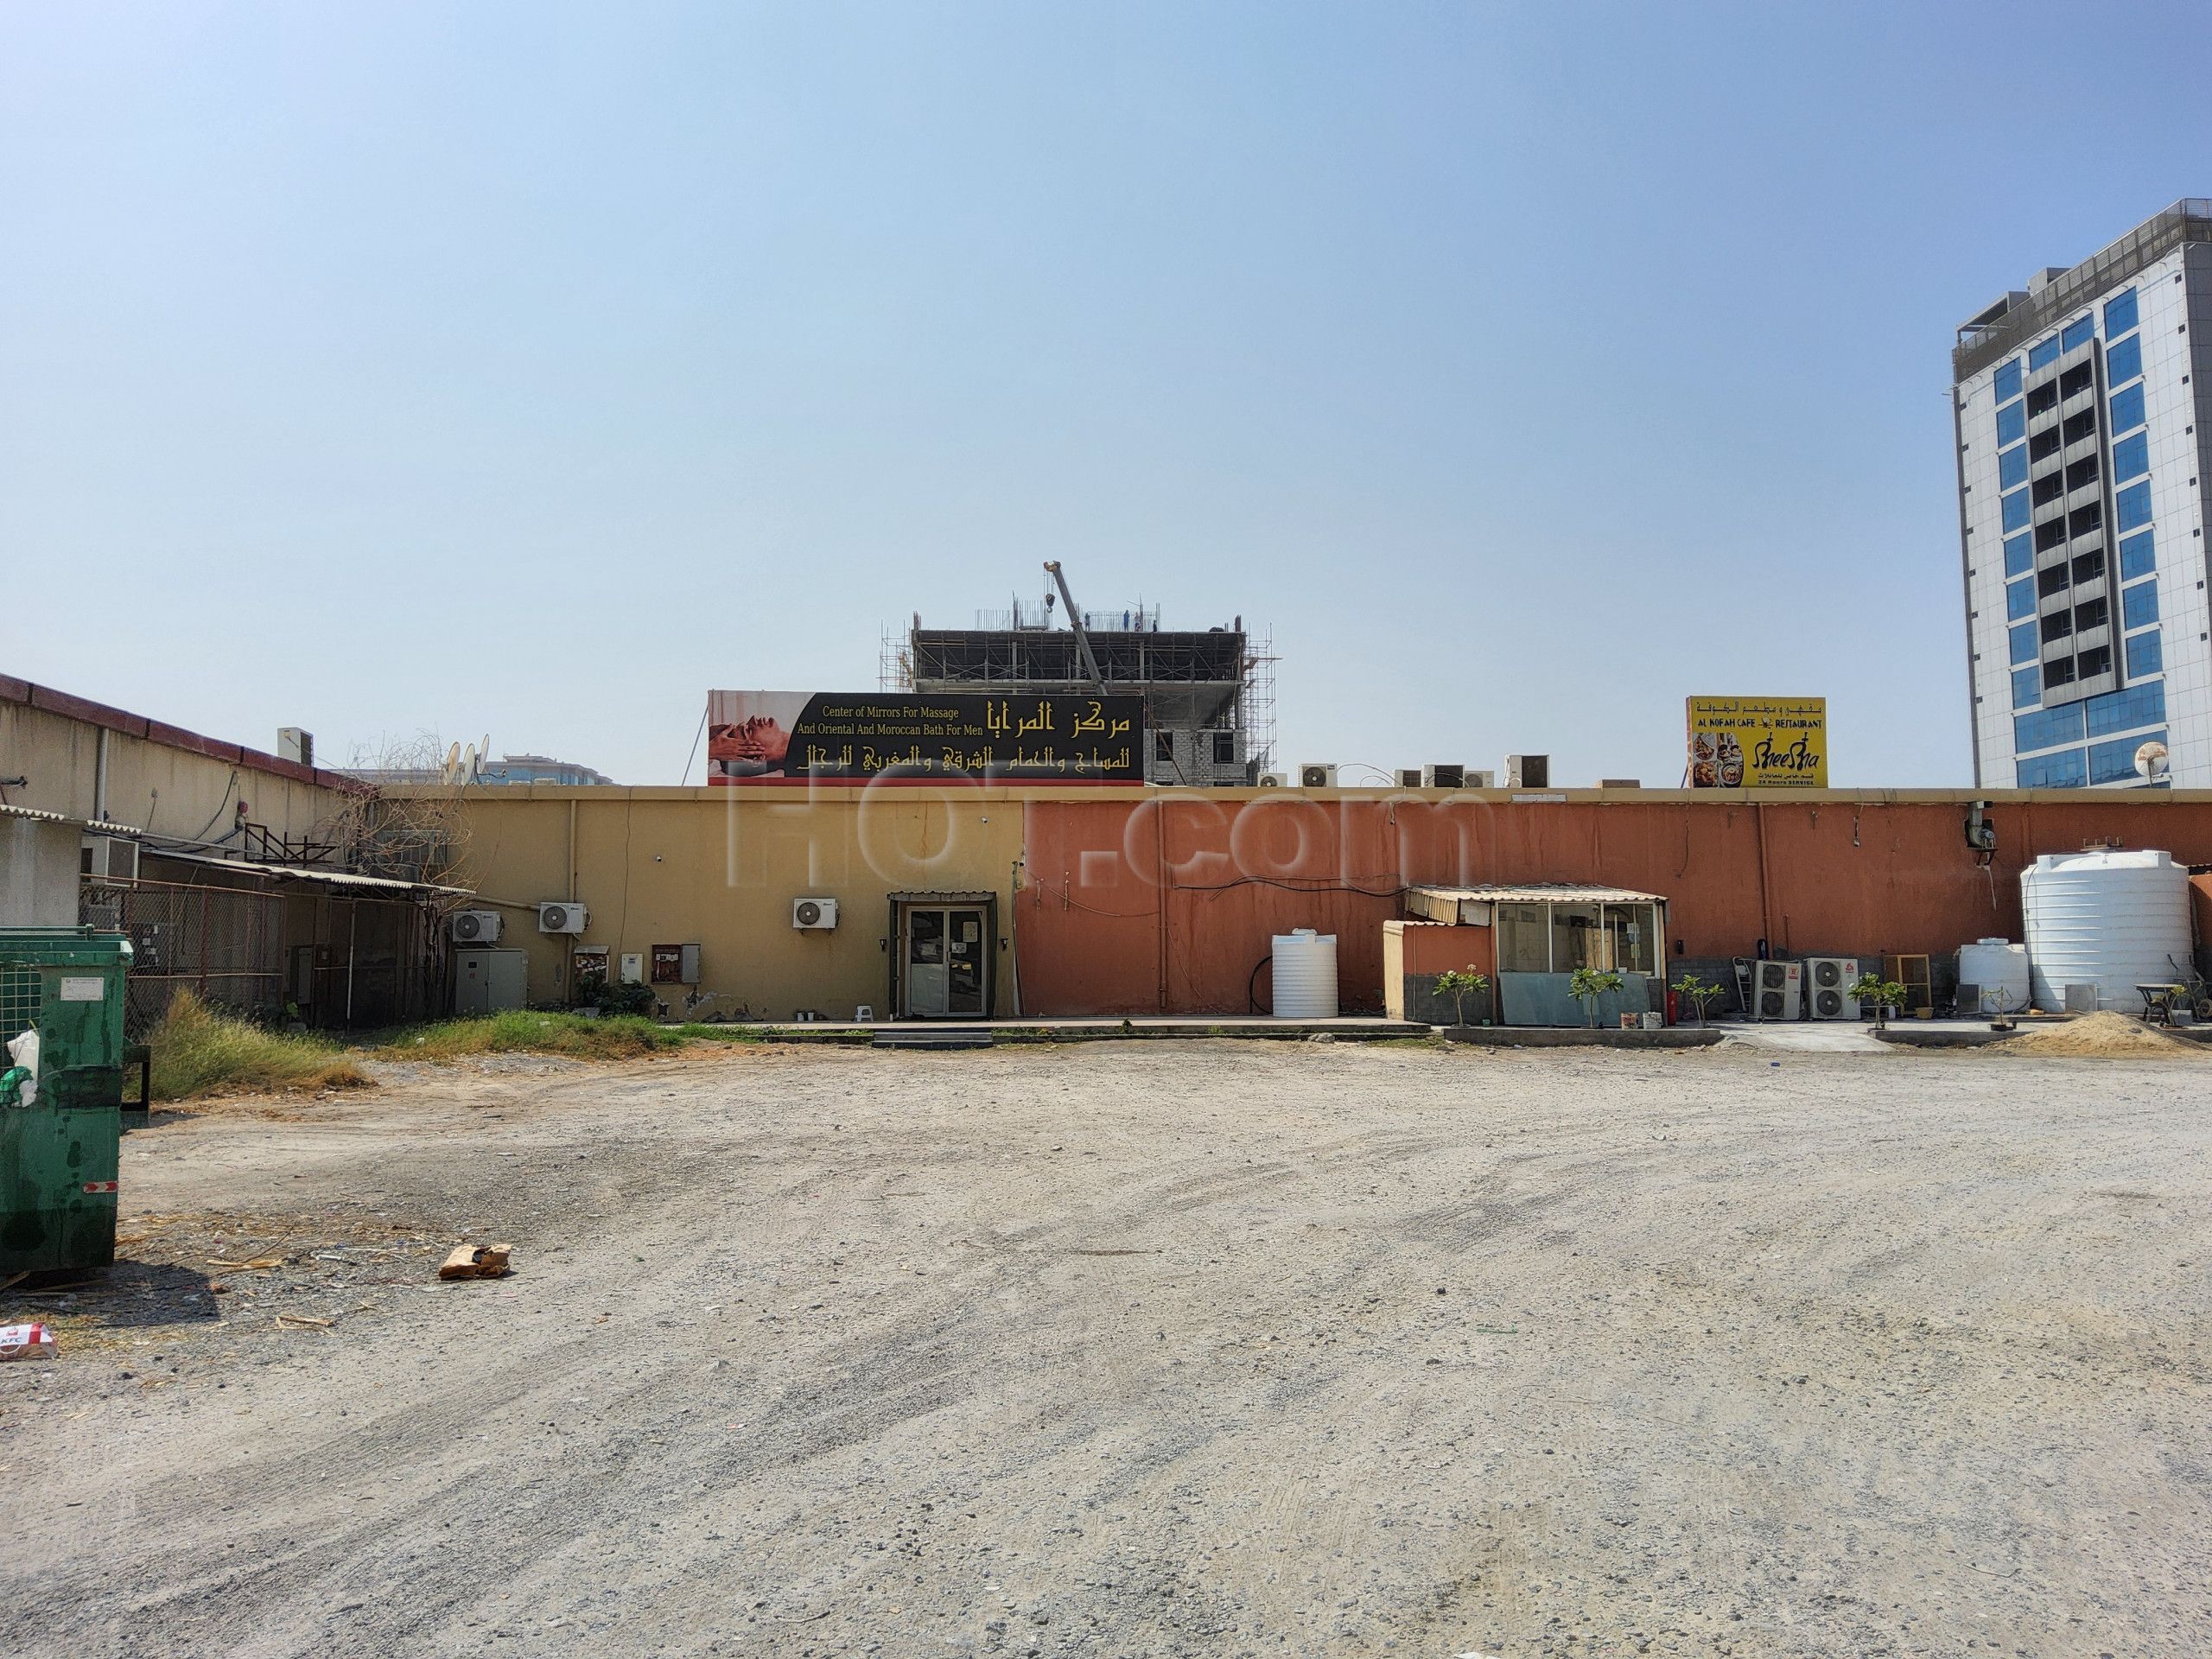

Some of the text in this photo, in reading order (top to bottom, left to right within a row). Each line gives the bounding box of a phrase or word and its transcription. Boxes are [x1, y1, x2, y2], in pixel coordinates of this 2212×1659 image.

[823, 705, 959, 721] Center of Mirrors For Massage
[987, 700, 1130, 739] مركز المرايا
[798, 722, 983, 736] And Oriental And Moroccan Bath For Men
[1698, 718, 1822, 729] AL KOFAH CAFE RESTAURANT
[796, 744, 1130, 774] للمساج والحمام الشرقي والمغربي للرجال
